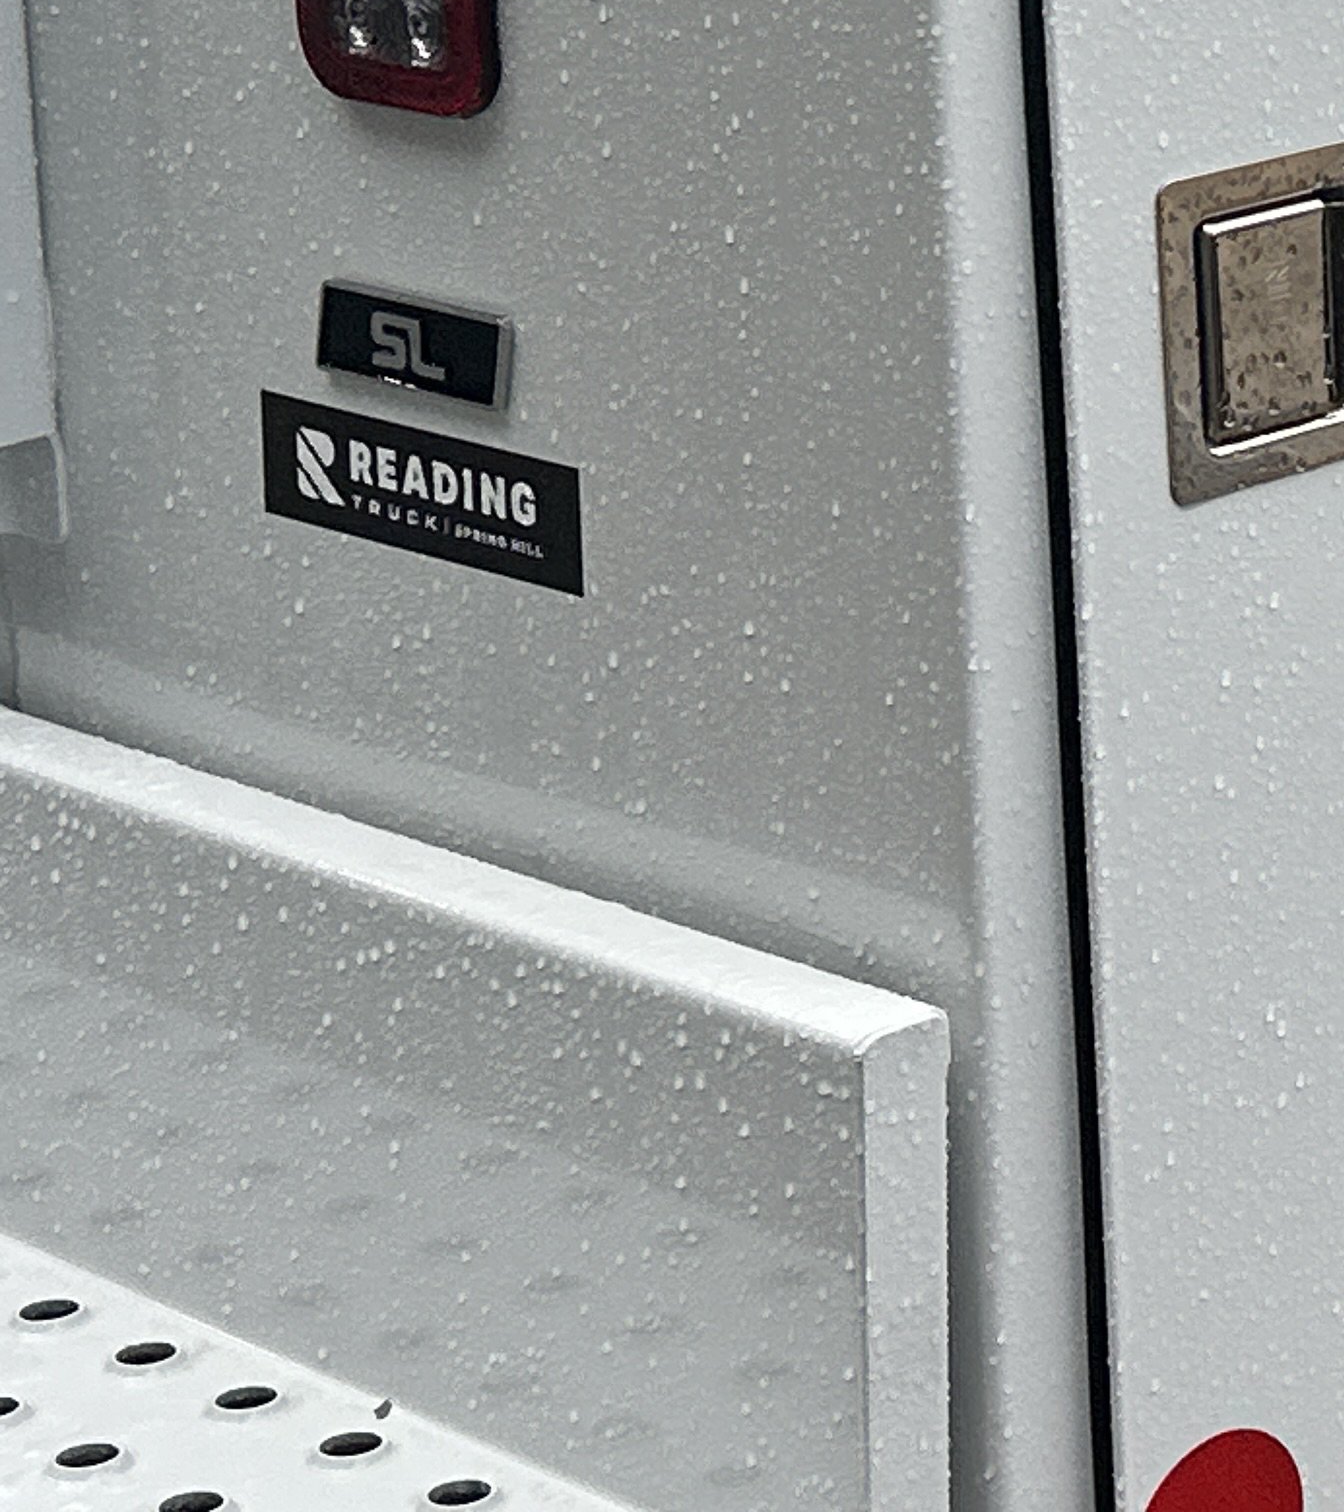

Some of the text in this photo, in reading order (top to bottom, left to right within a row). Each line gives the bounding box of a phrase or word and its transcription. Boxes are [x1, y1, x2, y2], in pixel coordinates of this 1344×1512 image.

[370, 311, 446, 381] SL
[348, 439, 537, 527] READING
[351, 494, 438, 531] TRUCK
[454, 522, 508, 550] SPRING
